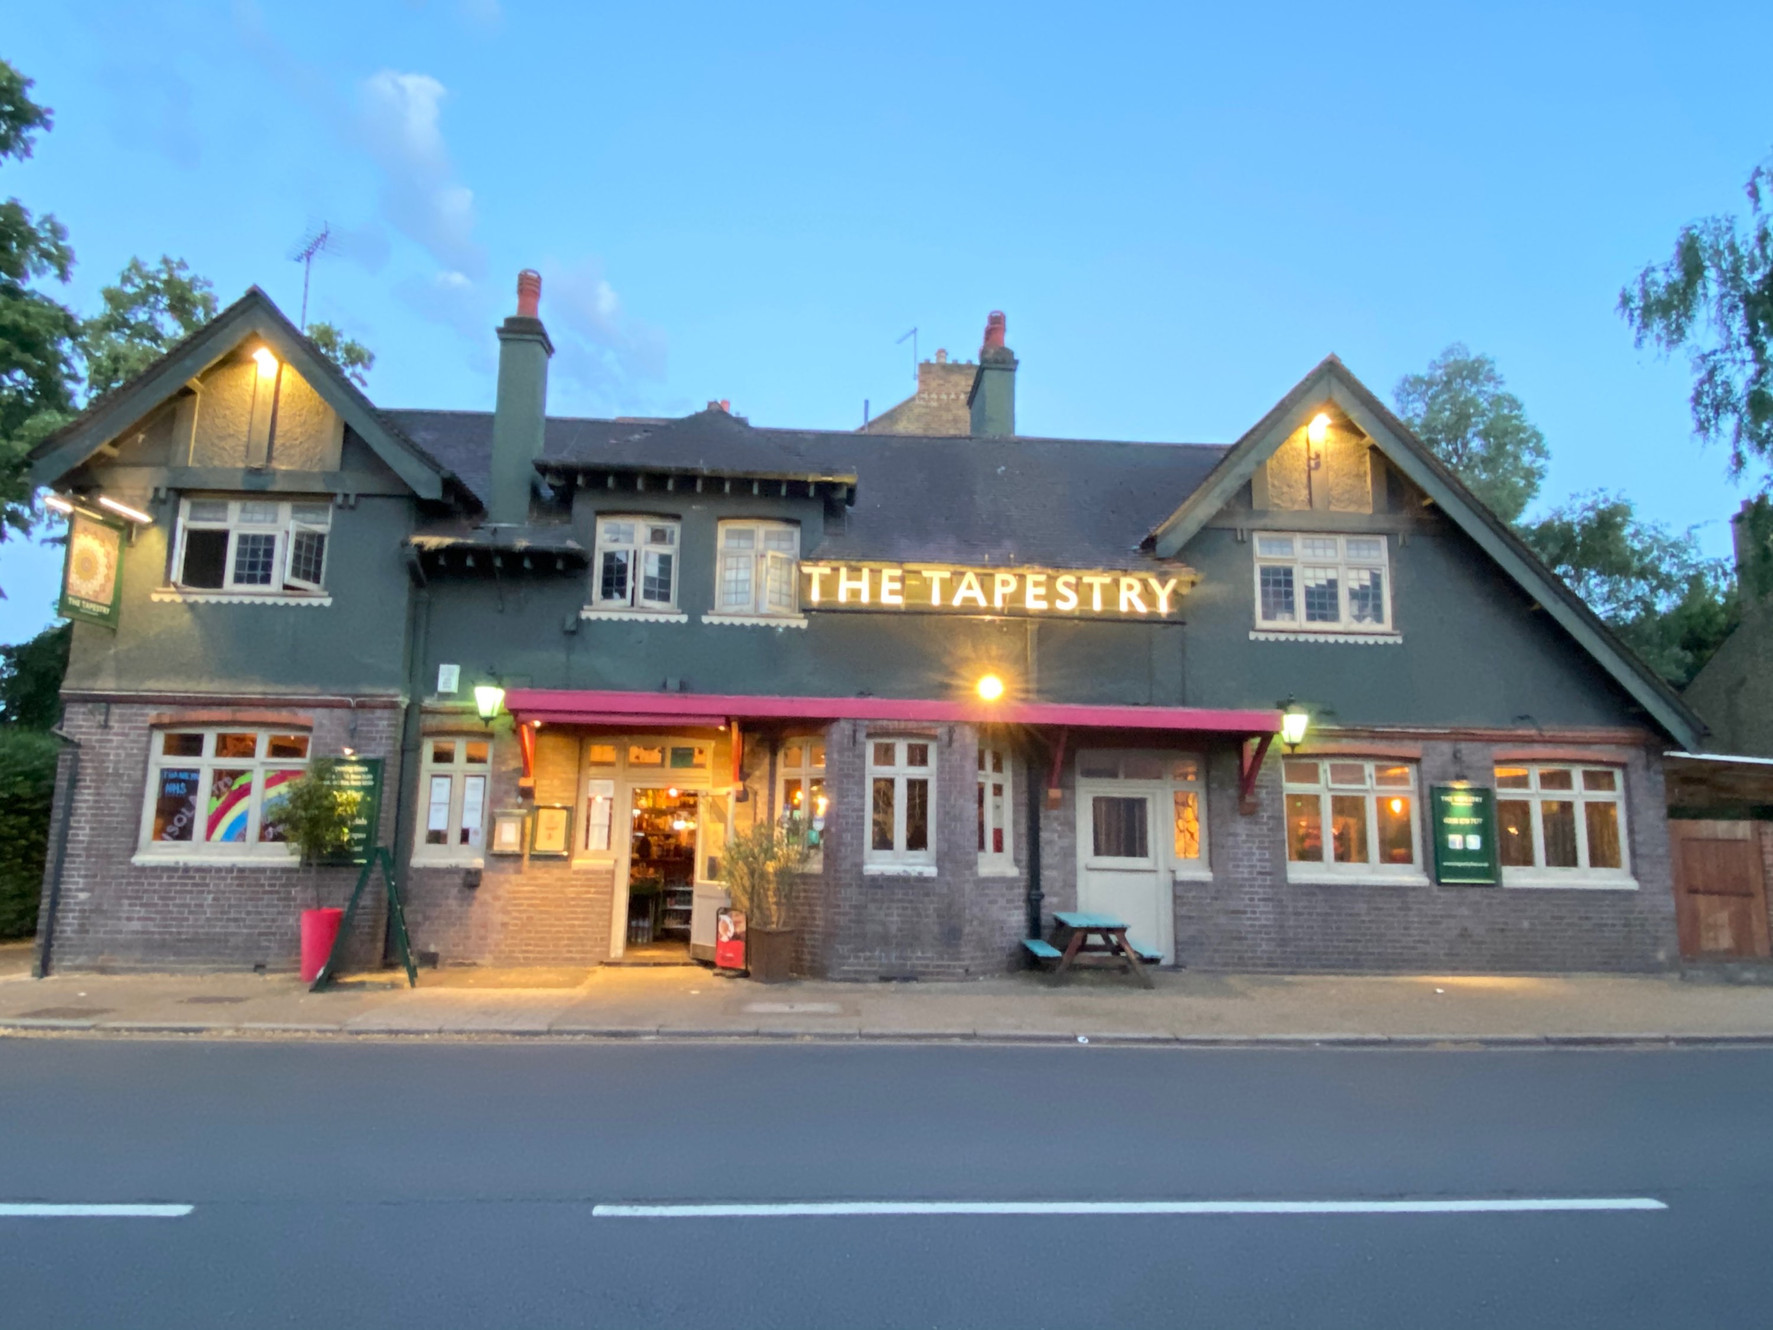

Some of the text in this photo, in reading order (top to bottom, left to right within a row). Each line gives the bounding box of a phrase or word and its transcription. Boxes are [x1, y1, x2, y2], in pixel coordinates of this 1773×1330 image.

[801, 566, 1179, 617] THE TAPESTRY
[68, 596, 82, 609] THE
[82, 601, 110, 615] TAPESTRY
[165, 782, 188, 794] NHS
